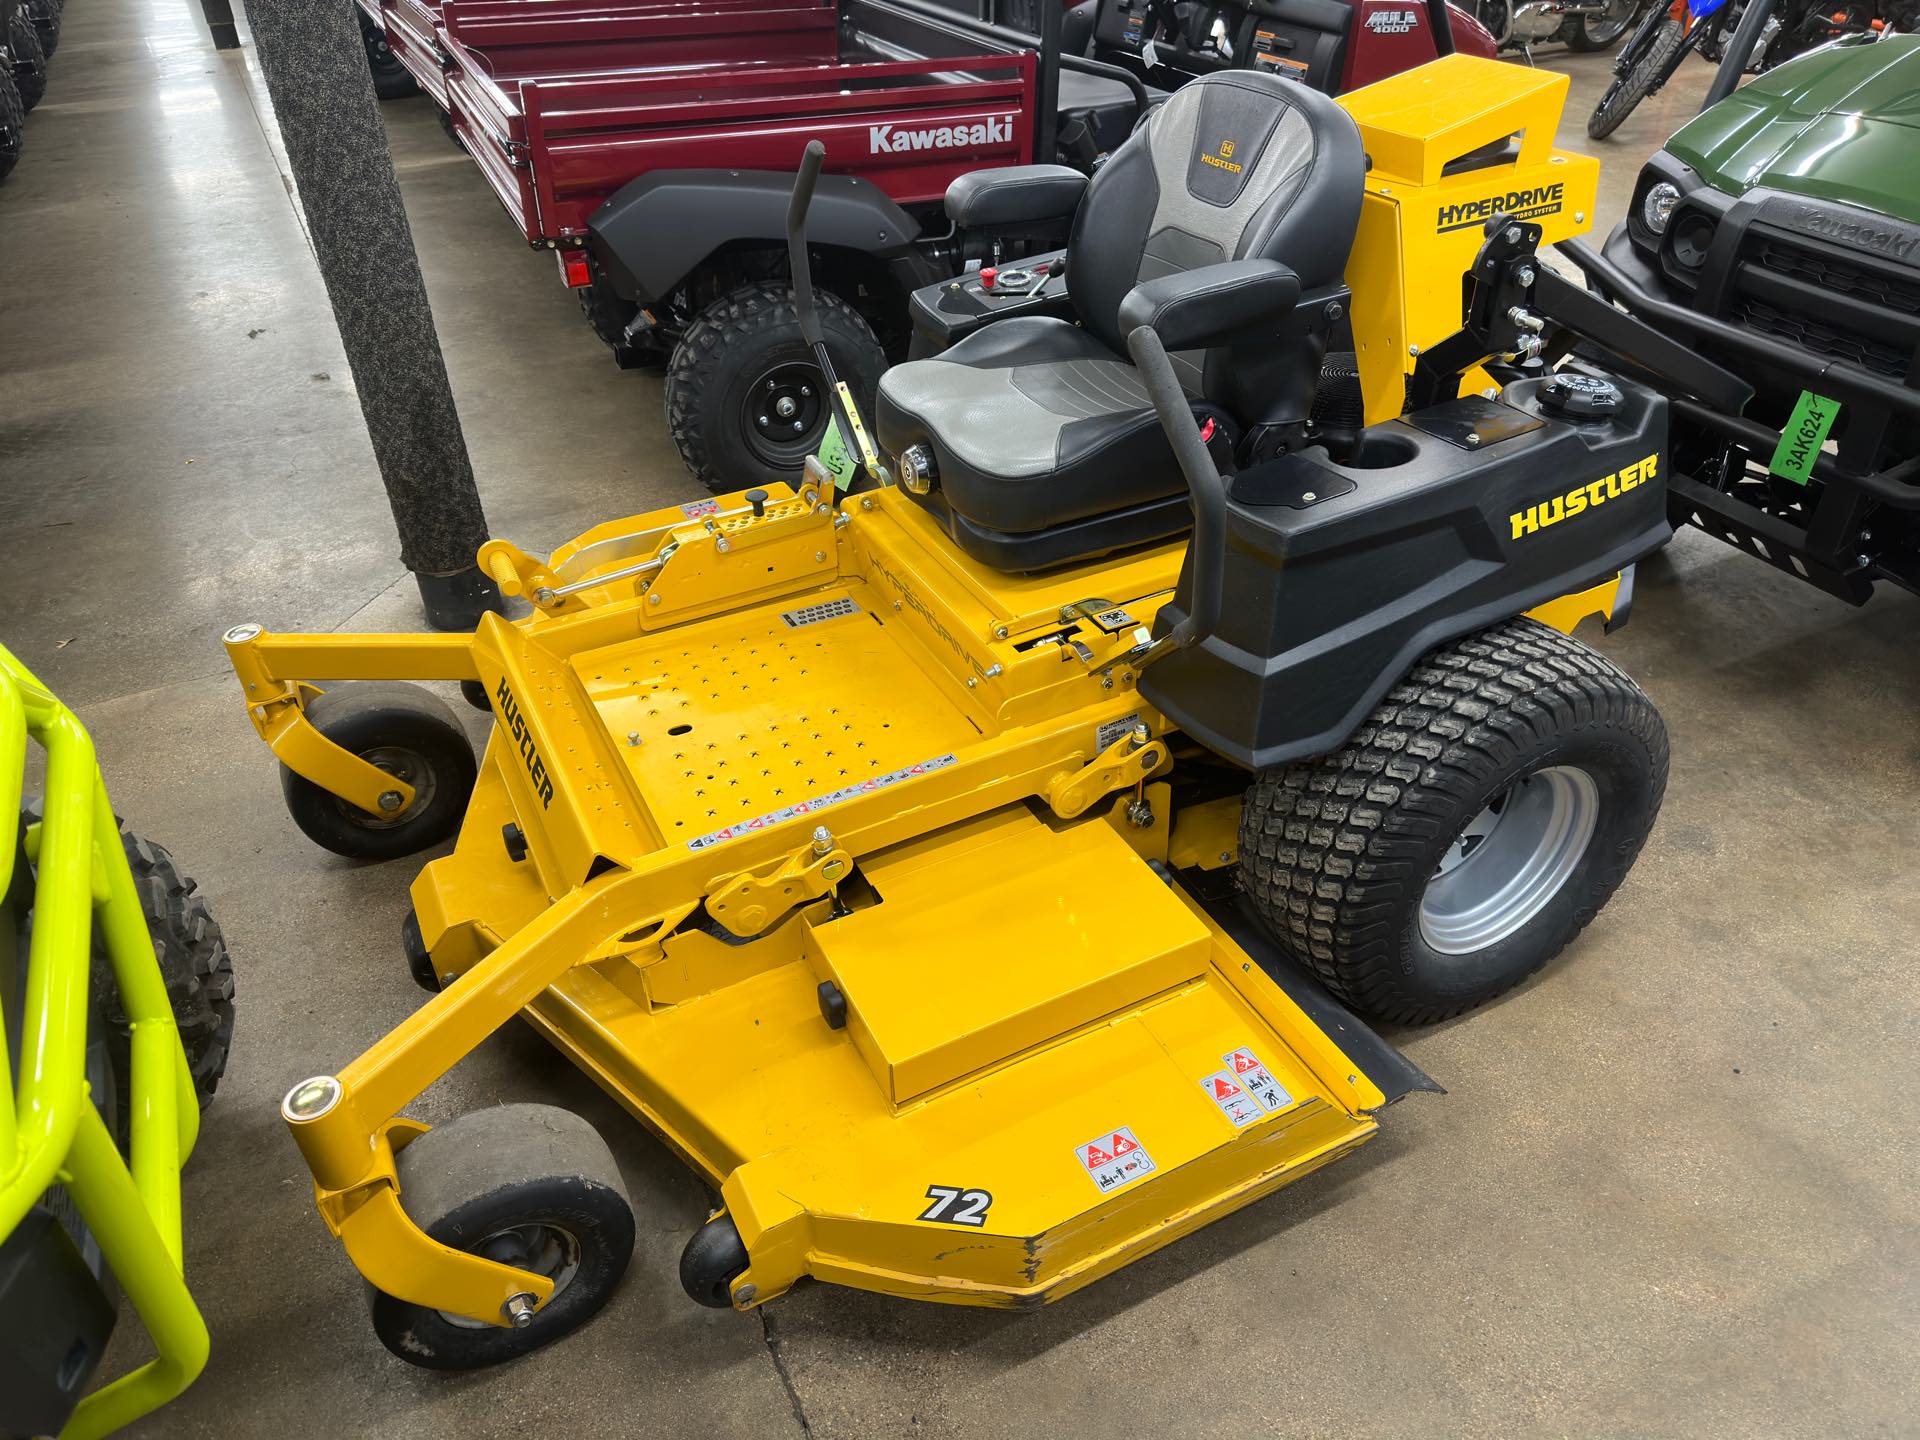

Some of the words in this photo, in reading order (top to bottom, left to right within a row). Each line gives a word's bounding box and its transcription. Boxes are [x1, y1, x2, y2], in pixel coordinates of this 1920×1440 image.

[1364, 11, 1418, 28] MULE
[1373, 26, 1410, 34] 4000
[869, 115, 1013, 155] Kawasaki
[1201, 153, 1242, 174] HUSTLER
[1534, 205, 1557, 216] SYSTEM
[1785, 409, 1825, 471] 3AK624
[1510, 453, 1659, 540] HUSTLER
[496, 675, 554, 812] HUSTLER
[919, 1186, 991, 1225] 72
